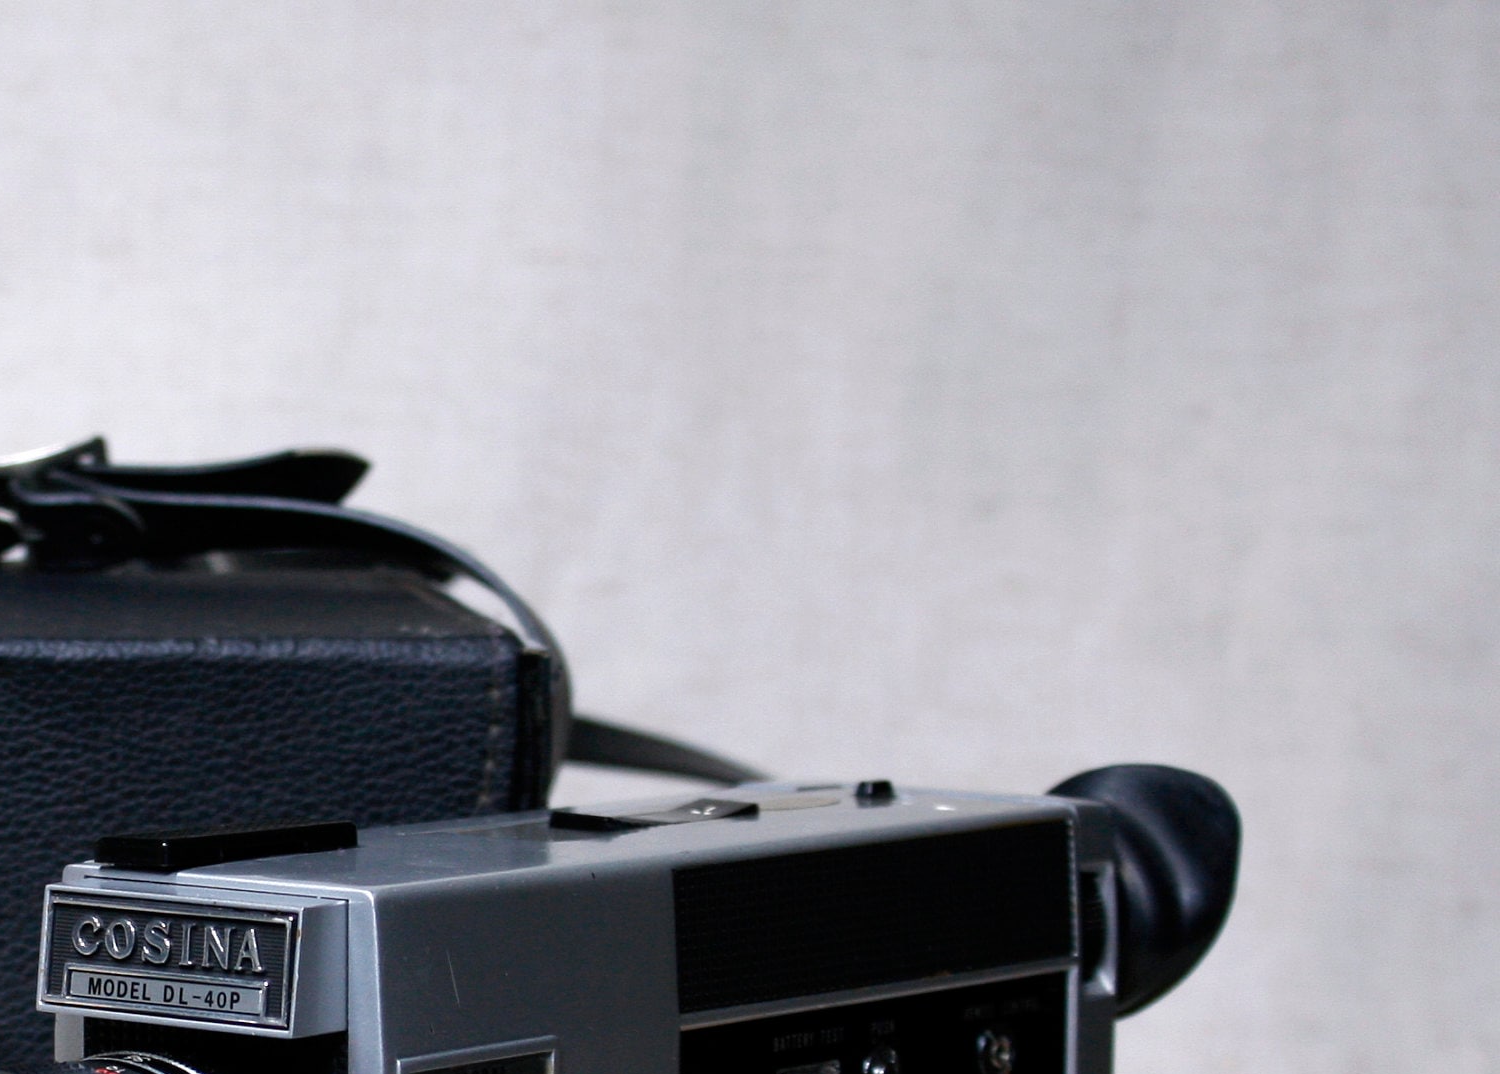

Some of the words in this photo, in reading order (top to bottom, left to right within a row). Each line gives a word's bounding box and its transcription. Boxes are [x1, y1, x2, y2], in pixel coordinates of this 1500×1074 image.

[71, 914, 265, 974] COSINA
[87, 976, 151, 1001] MODEL
[162, 984, 241, 1010] DL-40P
